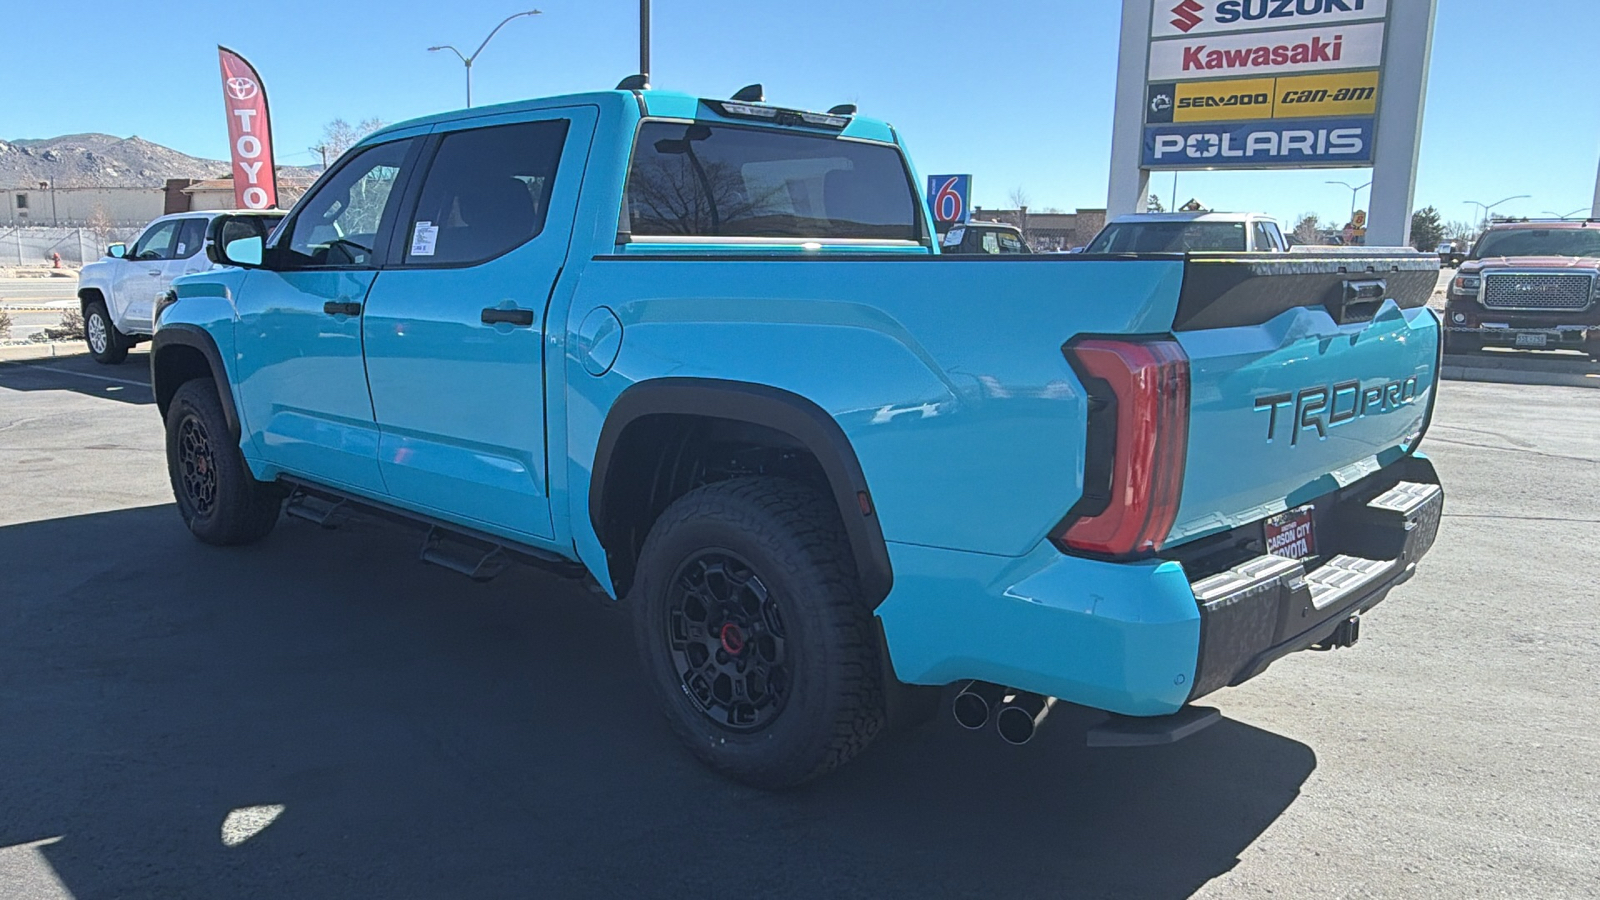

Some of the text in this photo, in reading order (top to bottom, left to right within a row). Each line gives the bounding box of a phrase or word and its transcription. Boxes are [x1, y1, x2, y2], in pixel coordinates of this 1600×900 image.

[1182, 35, 1342, 70] Kawasaki
[1154, 128, 1362, 158] POLARIS
[935, 177, 962, 221] 6
[1268, 529, 1295, 550] CARSON
[1297, 522, 1311, 538] CITY
[1273, 538, 1308, 559] OYOTA
